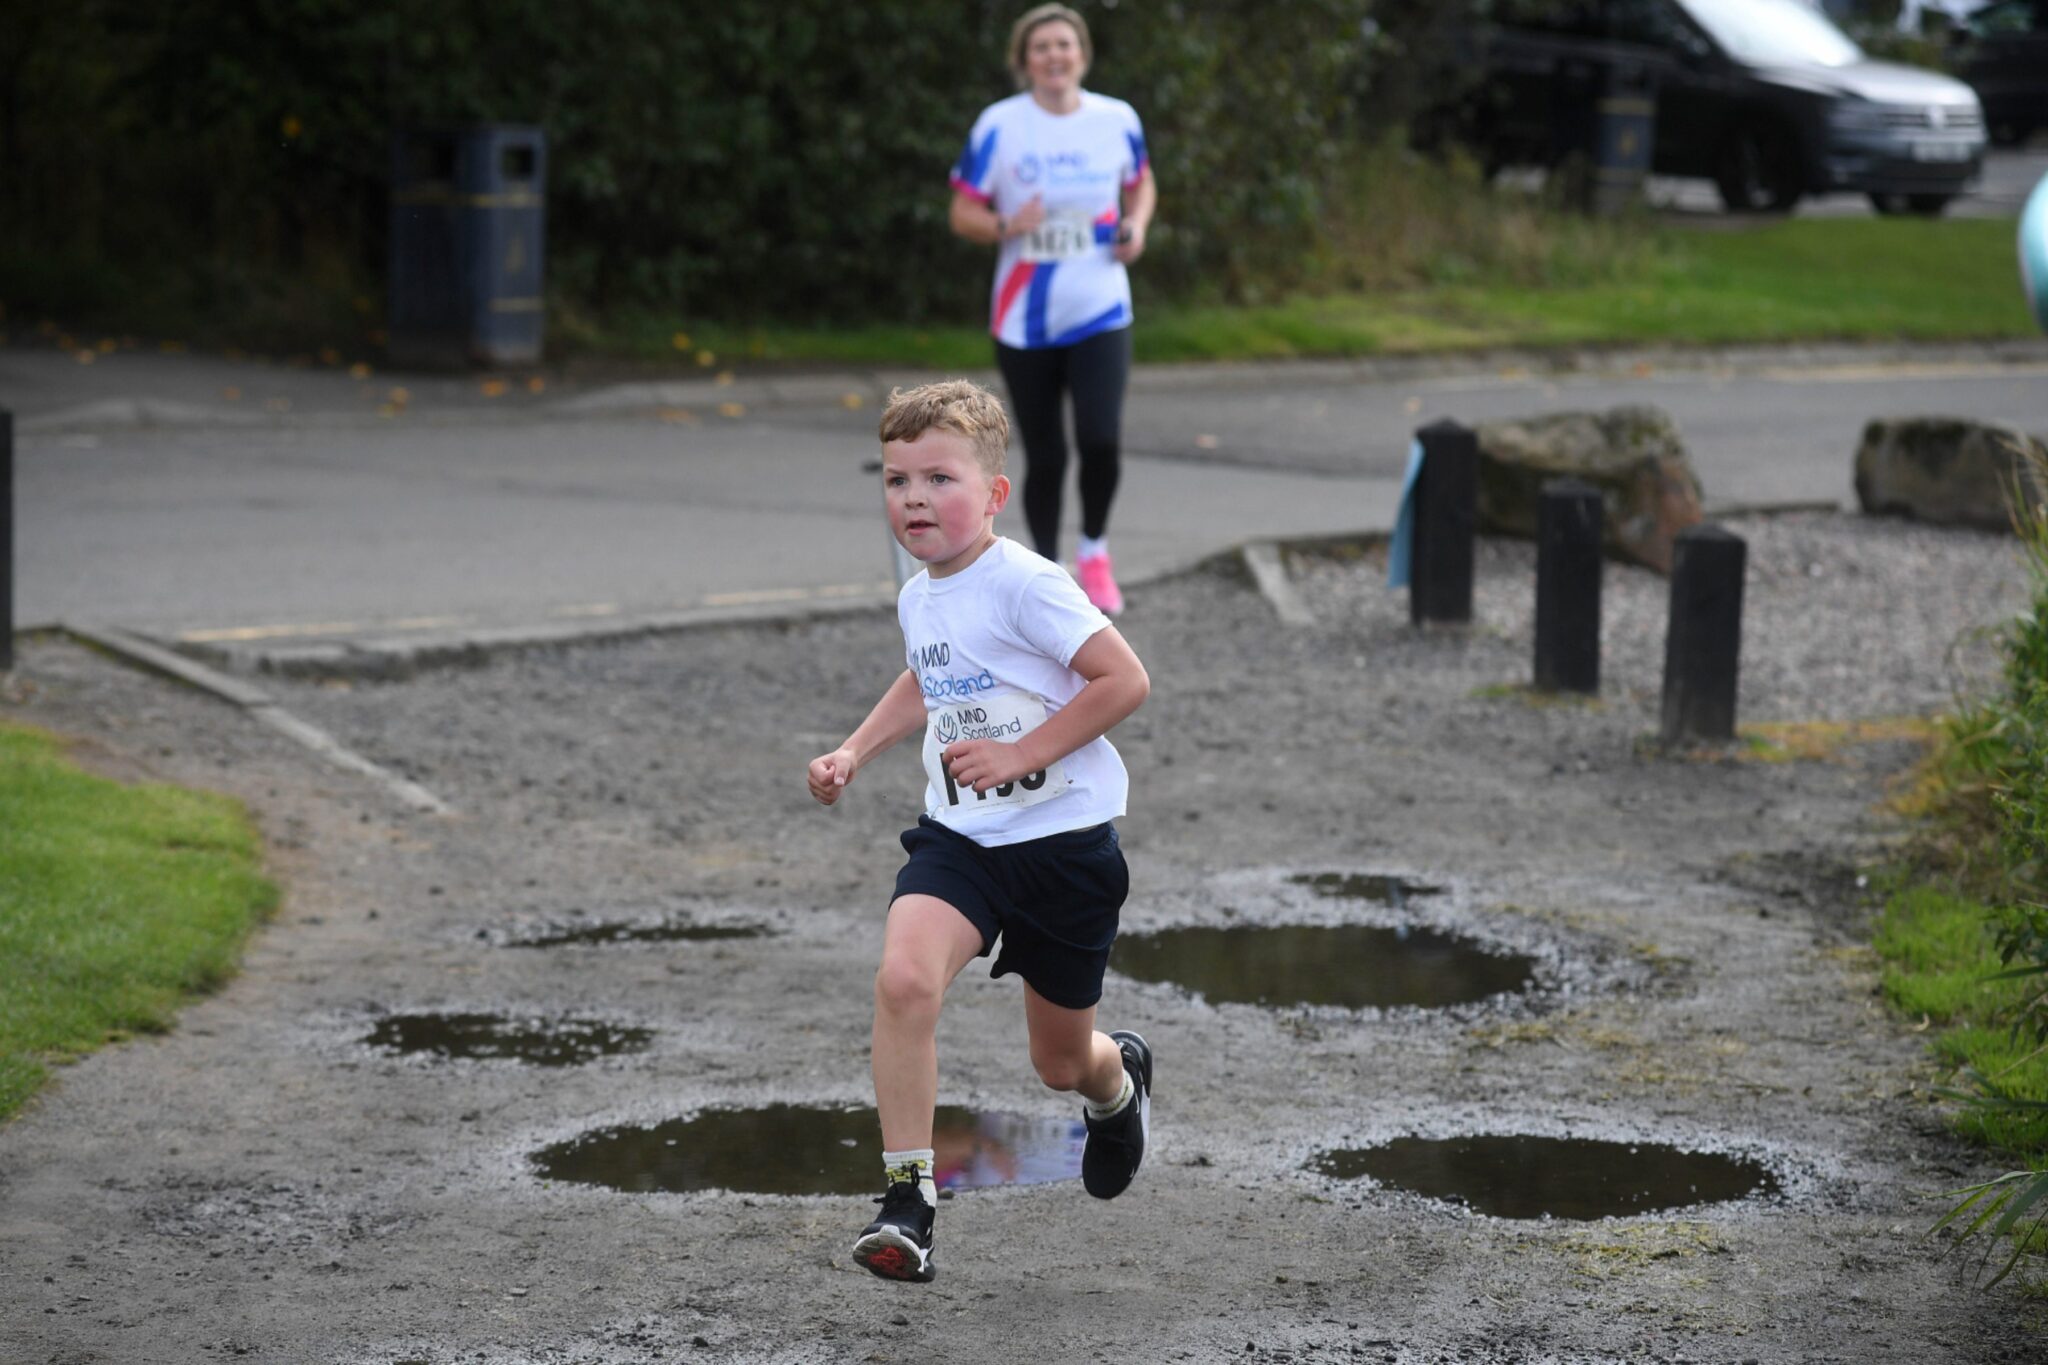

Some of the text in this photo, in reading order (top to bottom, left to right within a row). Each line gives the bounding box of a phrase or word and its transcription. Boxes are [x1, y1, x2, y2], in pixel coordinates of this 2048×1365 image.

[922, 642, 950, 668] MND
[924, 669, 994, 697] Scoland
[957, 707, 987, 725] MND
[962, 716, 1022, 741] Scotland
